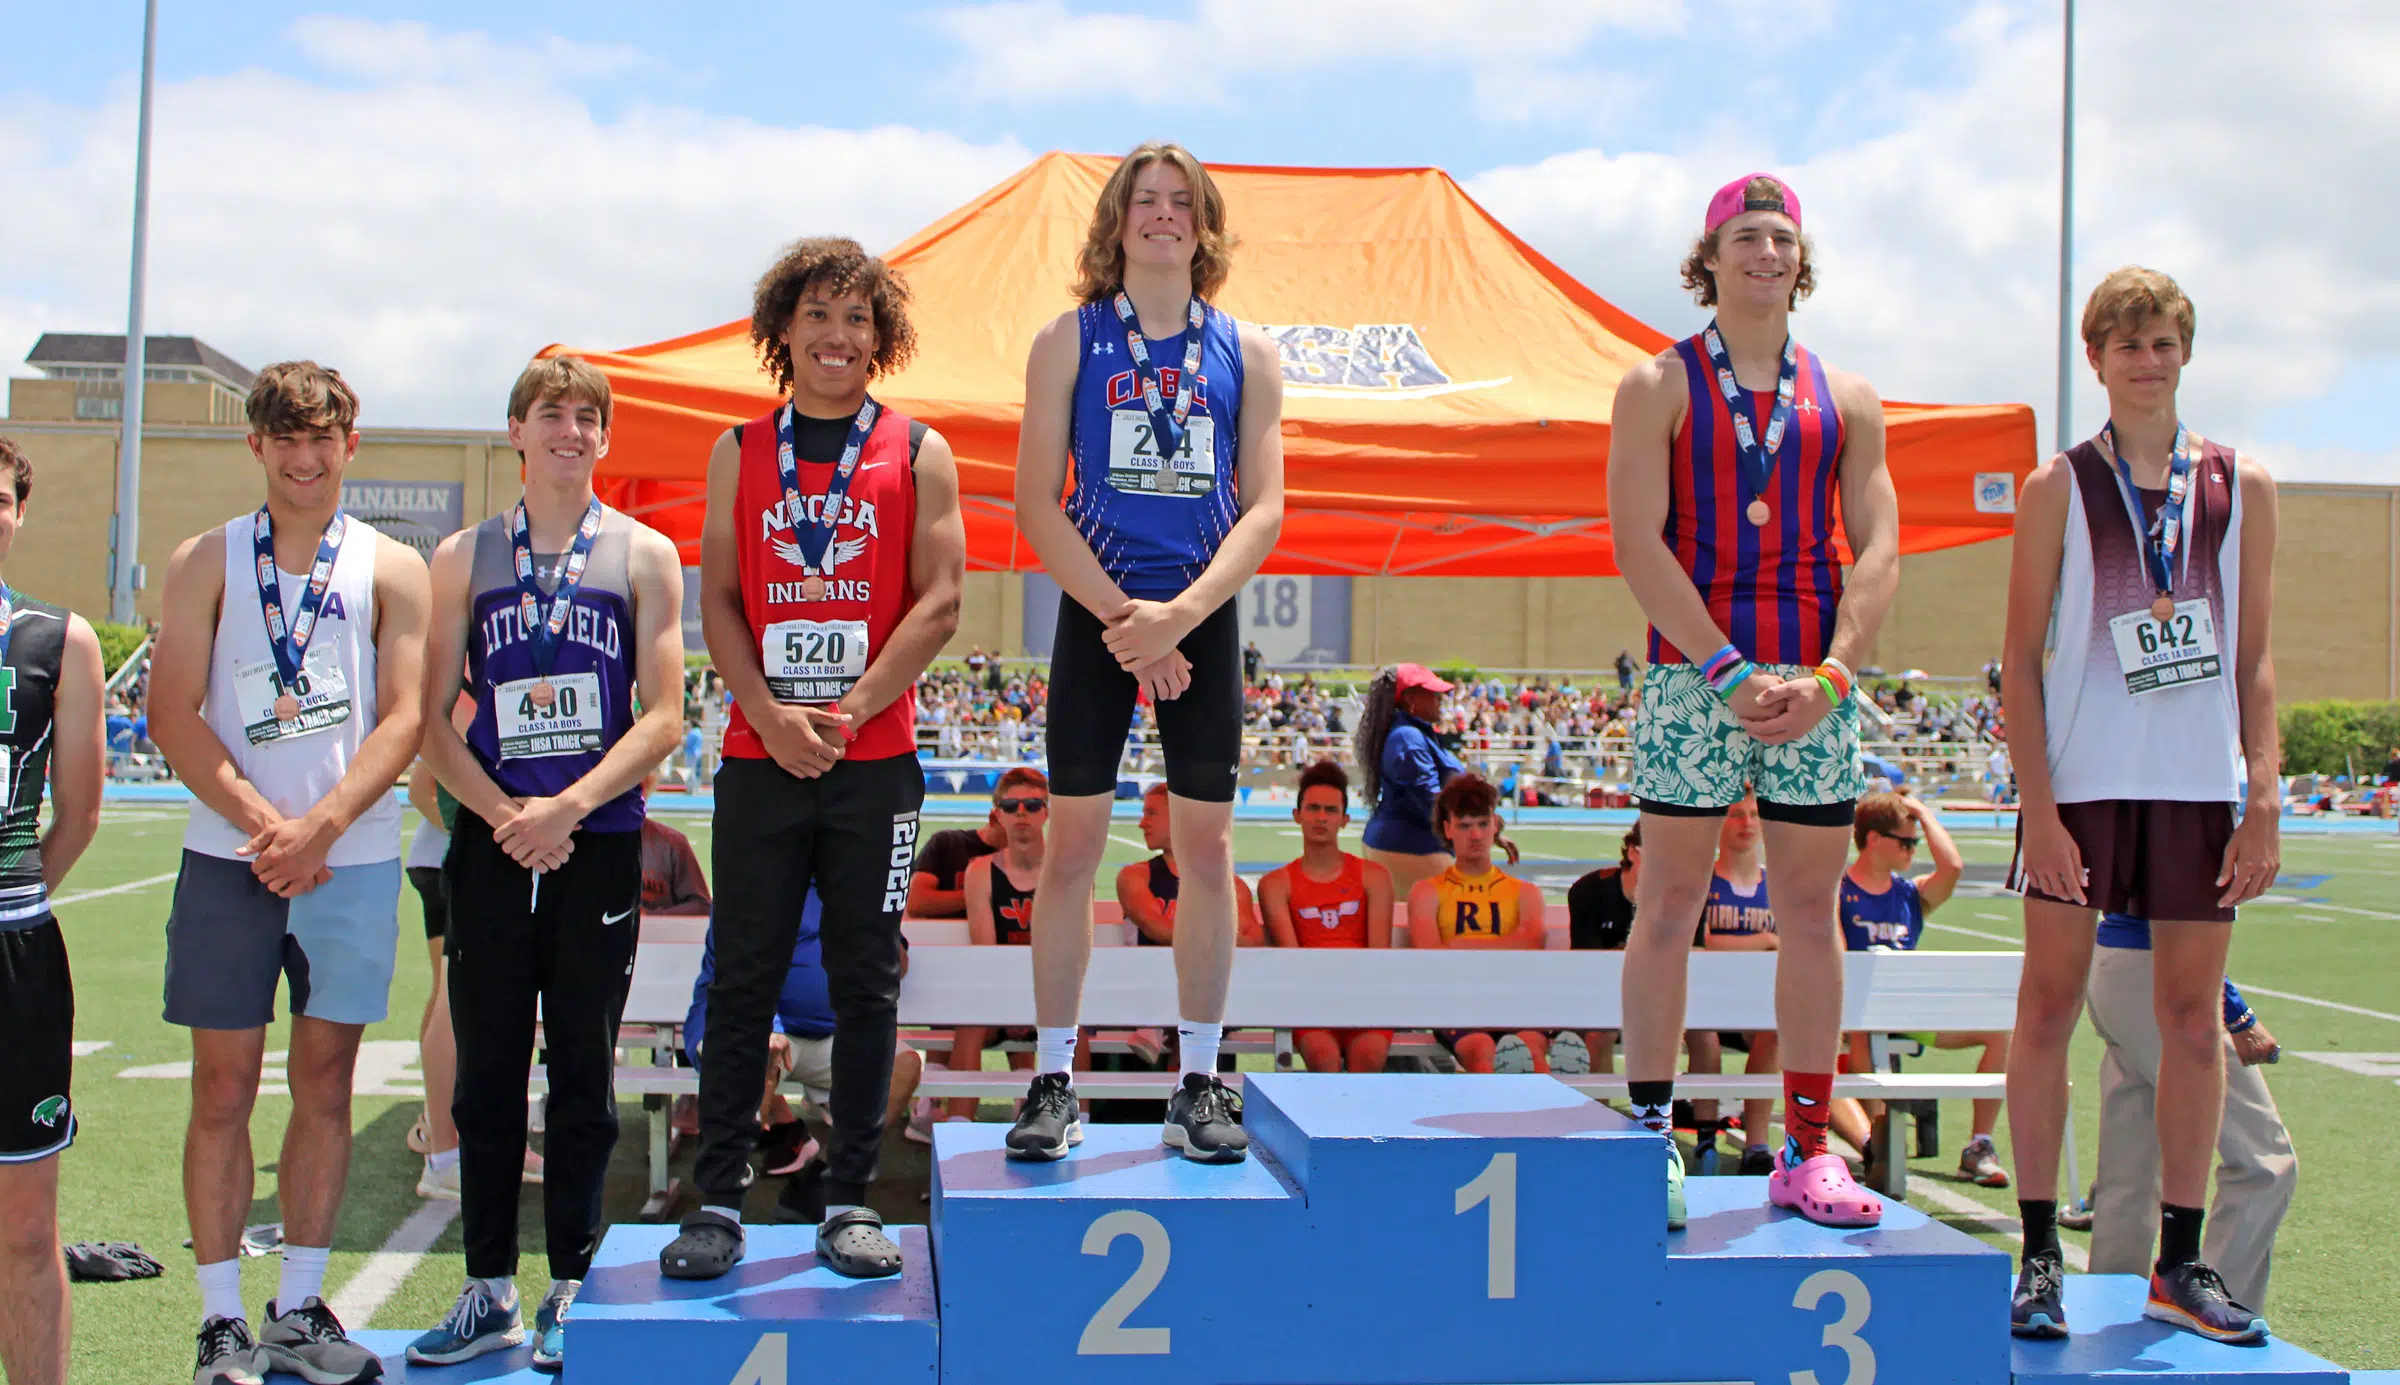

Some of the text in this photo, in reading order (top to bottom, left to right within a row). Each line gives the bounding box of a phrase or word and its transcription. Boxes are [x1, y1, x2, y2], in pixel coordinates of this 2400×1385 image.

[1133, 424, 1193, 458] 24
[1130, 458, 1158, 468] CLASS
[1173, 461, 1196, 471] BOYS
[1140, 473, 1156, 490] IHS
[762, 494, 879, 543] NOGA
[767, 579, 871, 604] INANS
[1253, 578, 1299, 628] 18
[483, 603, 619, 660] LITCIELD
[2136, 614, 2197, 654] 642
[785, 632, 845, 664] 520
[2141, 653, 2169, 666] CLASS
[2171, 650, 2182, 659] 1A
[782, 665, 845, 675] CLASS 1A BOYS
[306, 693, 329, 706] BOYS
[794, 682, 815, 697] IHSA
[815, 681, 842, 697] TRACK
[518, 719, 582, 733] CLASS 1A BOYS
[531, 736, 552, 752] IHSA
[552, 734, 581, 750] TRACK
[882, 820, 917, 912] 2022
[1455, 1152, 1517, 1299] 1
[1077, 1210, 1171, 1355] 2
[1789, 1269, 1877, 1385] 3
